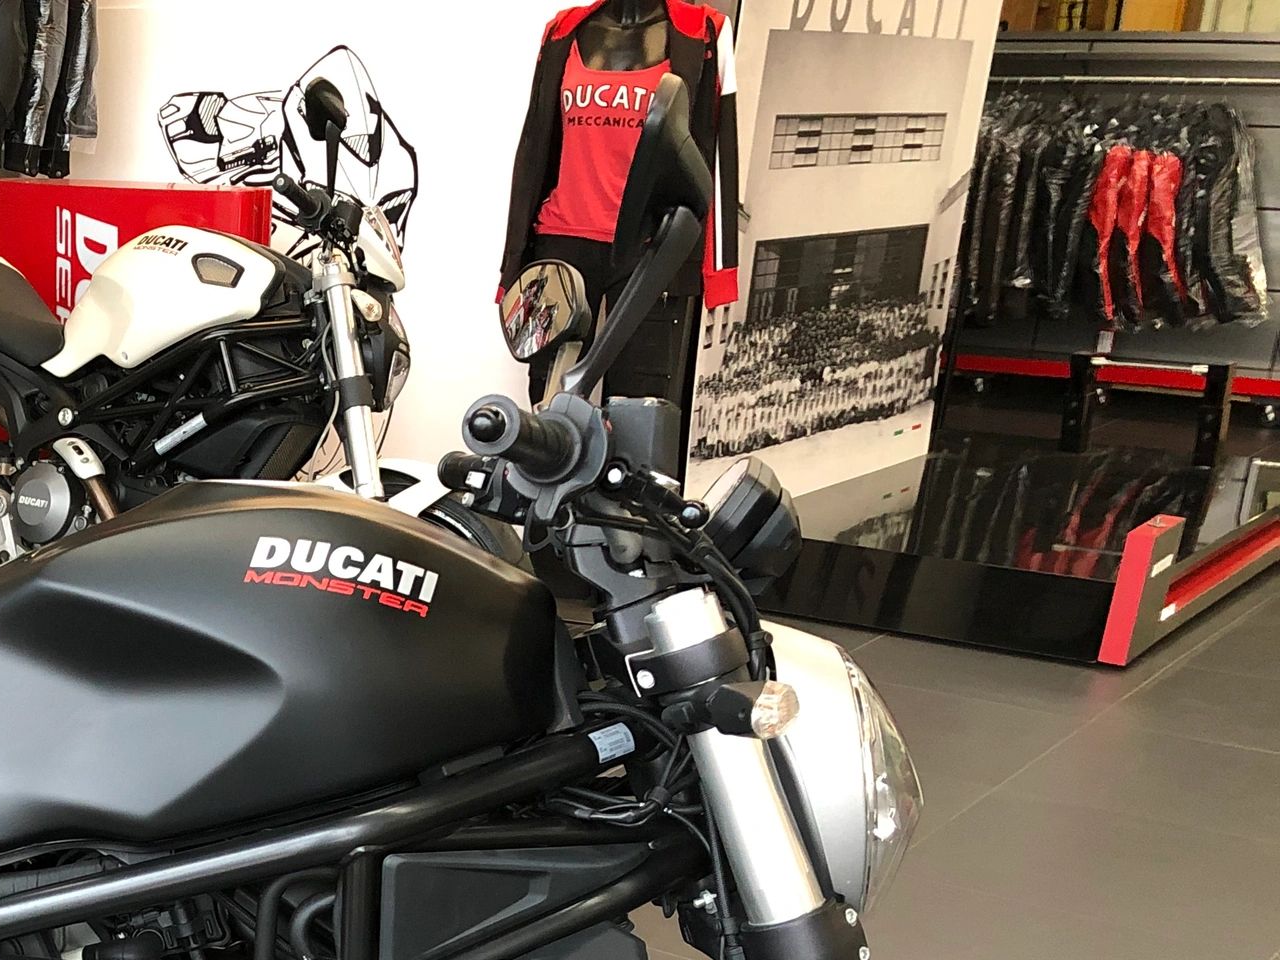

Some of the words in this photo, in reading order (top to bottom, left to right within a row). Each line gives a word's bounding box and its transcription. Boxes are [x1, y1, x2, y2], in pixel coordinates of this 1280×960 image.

[133, 245, 179, 256] MONSTER
[137, 235, 189, 251] DUCATI
[18, 495, 49, 508] DUCATI
[249, 536, 439, 603] DUCATI
[243, 570, 429, 618] MONSTER
